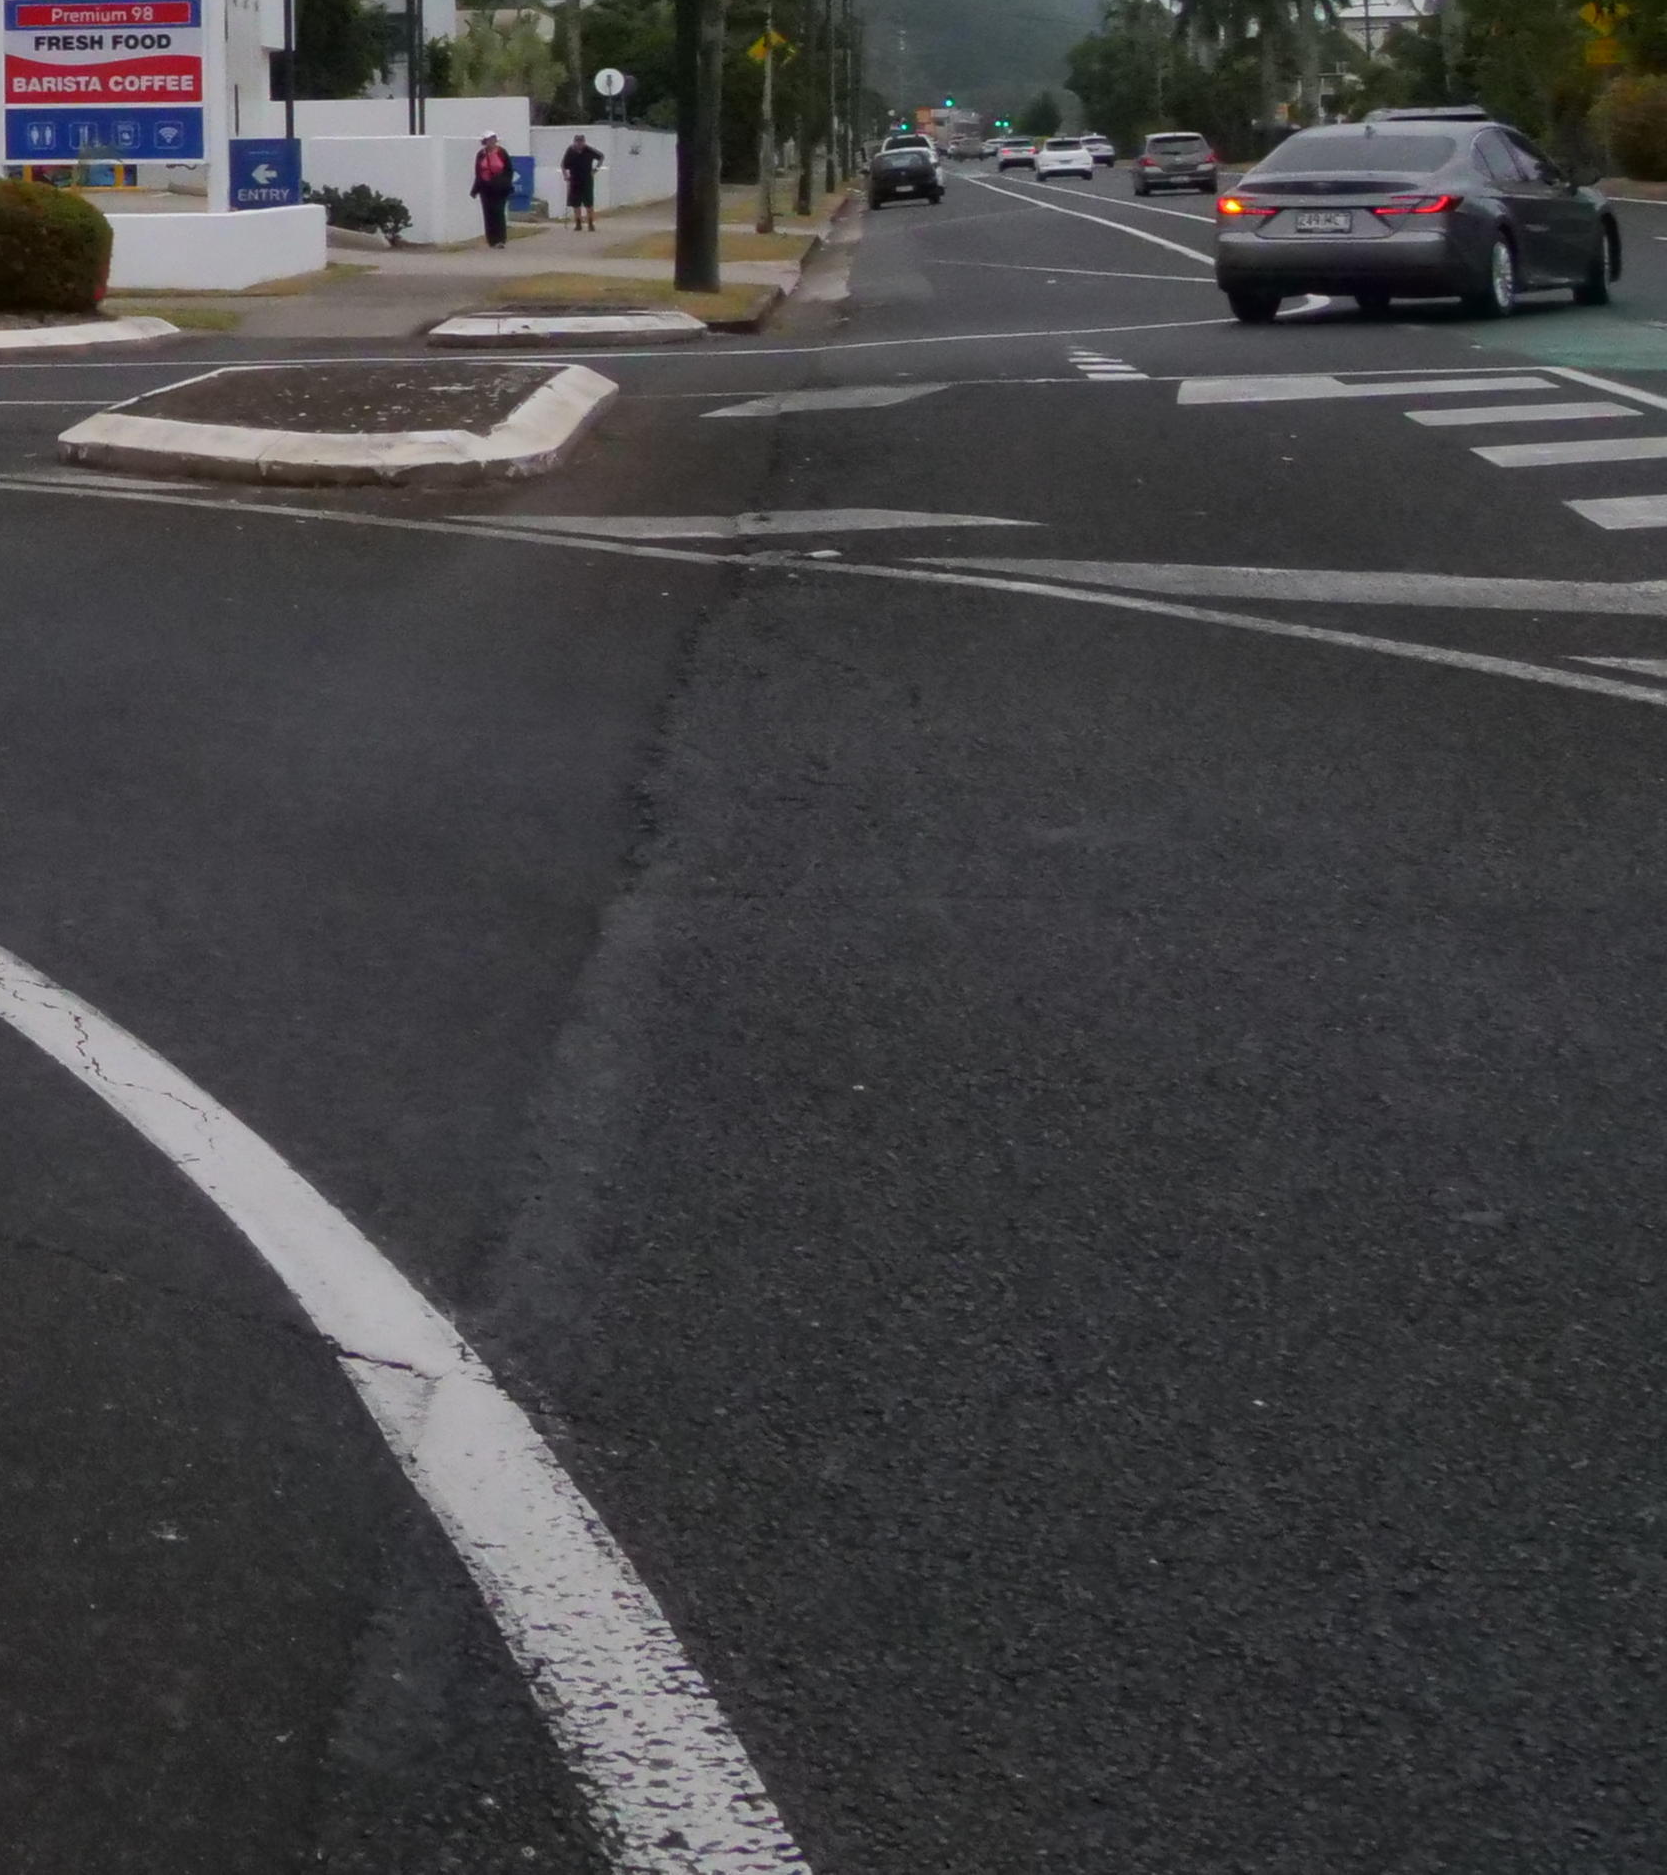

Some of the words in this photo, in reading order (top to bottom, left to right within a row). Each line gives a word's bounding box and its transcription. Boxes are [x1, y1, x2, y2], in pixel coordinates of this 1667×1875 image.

[50, 6, 127, 23] Premium
[131, 4, 154, 22] 98
[33, 34, 105, 51] FRESH
[112, 33, 172, 50] FOOD
[12, 76, 103, 93] BARISTA
[108, 74, 194, 92] COFFEE
[237, 188, 291, 202] ENTRY
